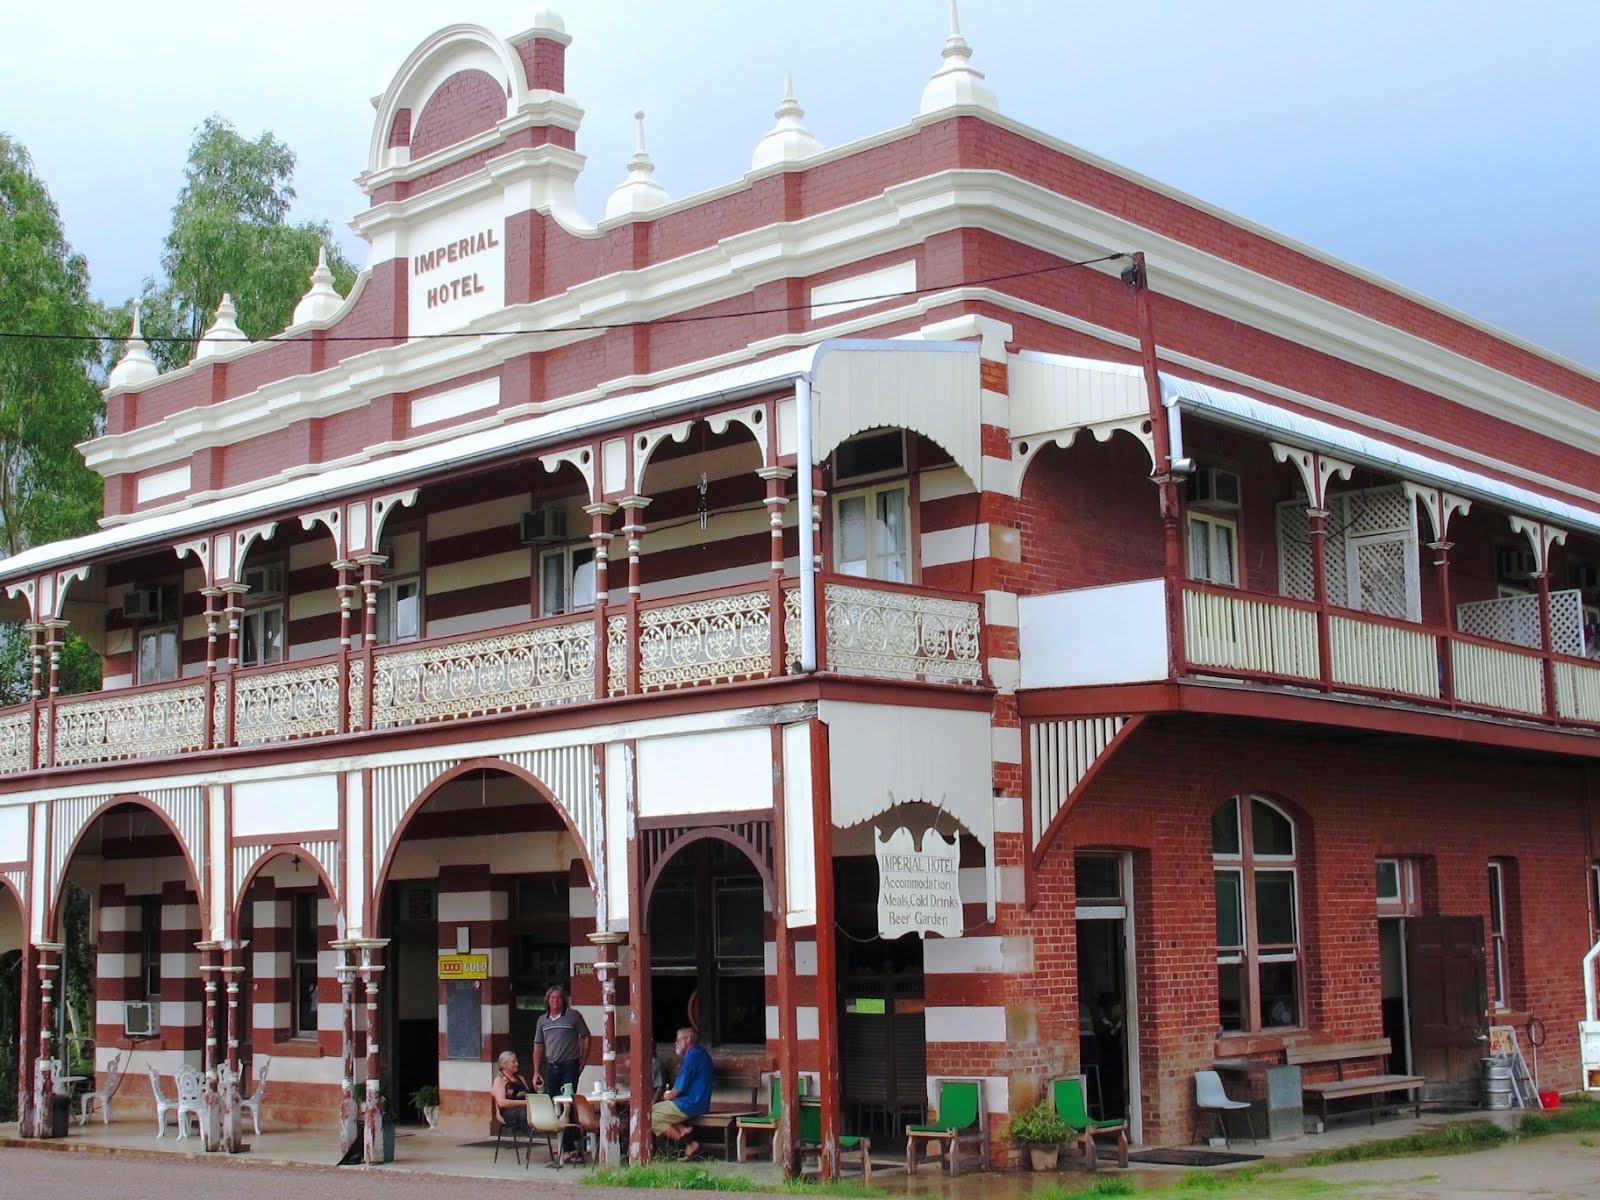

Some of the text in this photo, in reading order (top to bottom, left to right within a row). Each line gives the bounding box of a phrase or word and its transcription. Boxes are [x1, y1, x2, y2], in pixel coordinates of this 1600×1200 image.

[414, 229, 499, 276] IMPERIAL
[427, 273, 484, 309] HOTEL
[881, 855, 957, 873] IMPERIAL HOTEL
[883, 876, 951, 891] Accommodation
[930, 894, 959, 908] Drinks
[888, 911, 949, 926] Beer Garden
[464, 961, 487, 972] GOLD
[575, 965, 594, 975] Public
